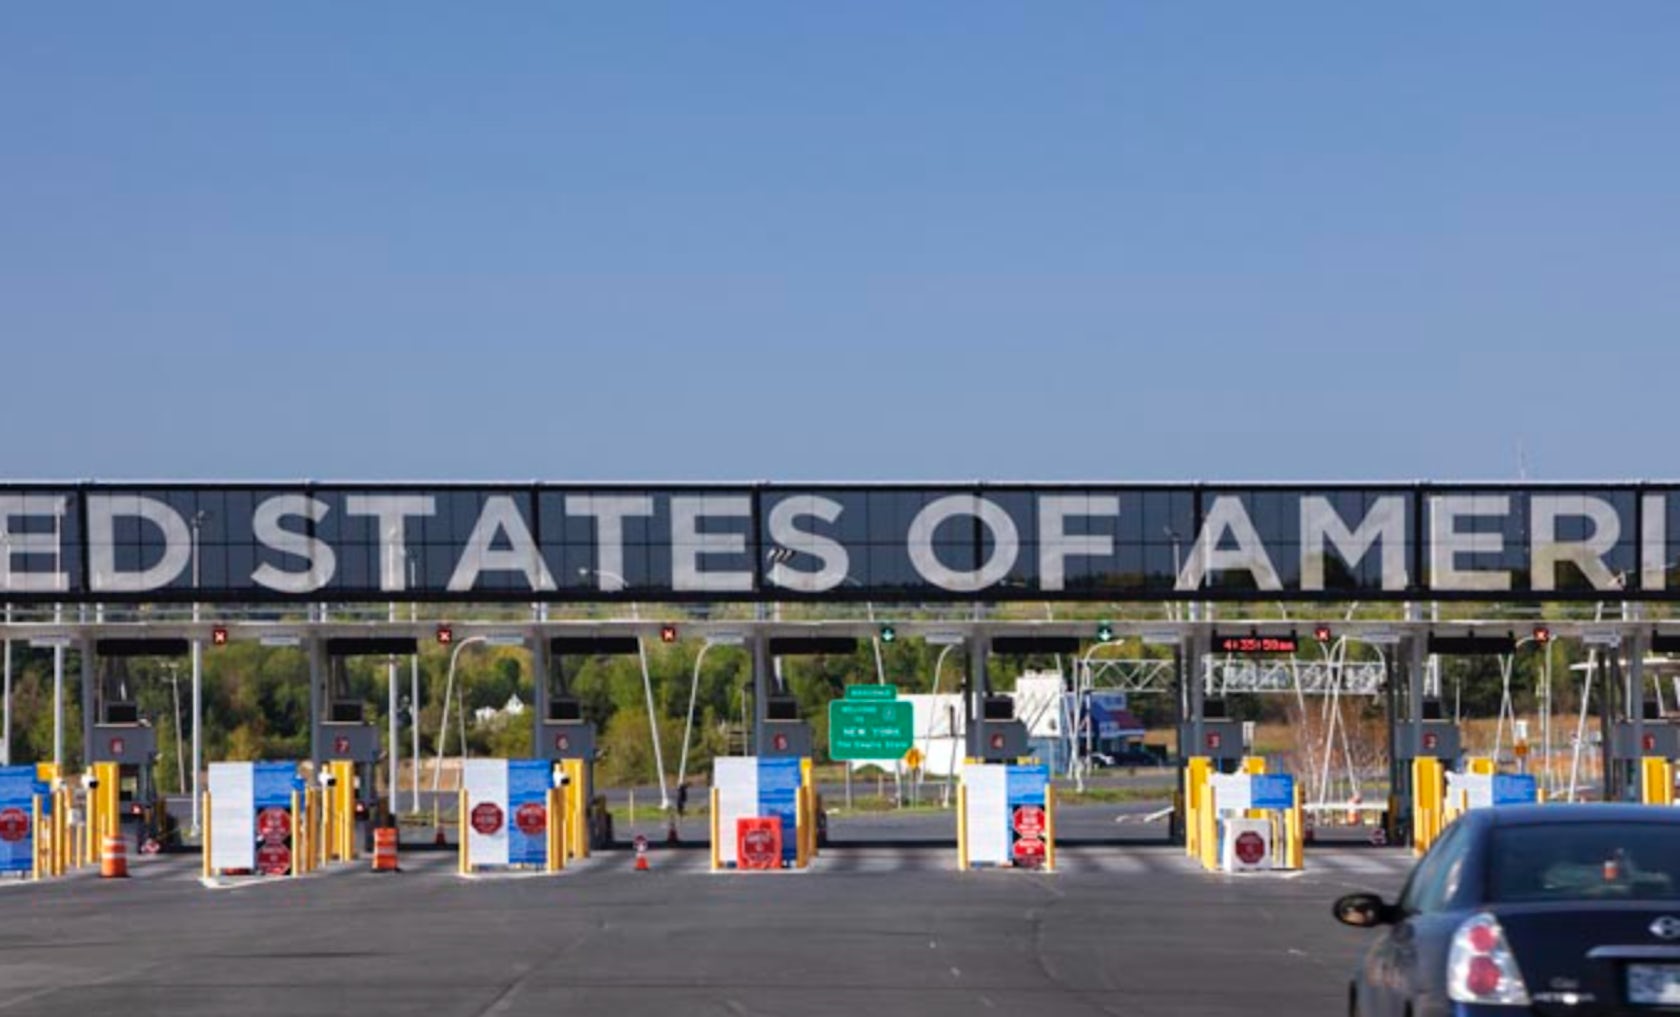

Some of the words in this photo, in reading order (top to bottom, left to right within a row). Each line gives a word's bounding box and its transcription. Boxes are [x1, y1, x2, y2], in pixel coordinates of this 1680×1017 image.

[0, 495, 192, 592] ED
[250, 494, 849, 592] STATES
[907, 494, 1120, 592] OF
[1173, 495, 1665, 592] AMERI
[843, 728, 866, 736] NEW
[872, 728, 900, 736] YORK
